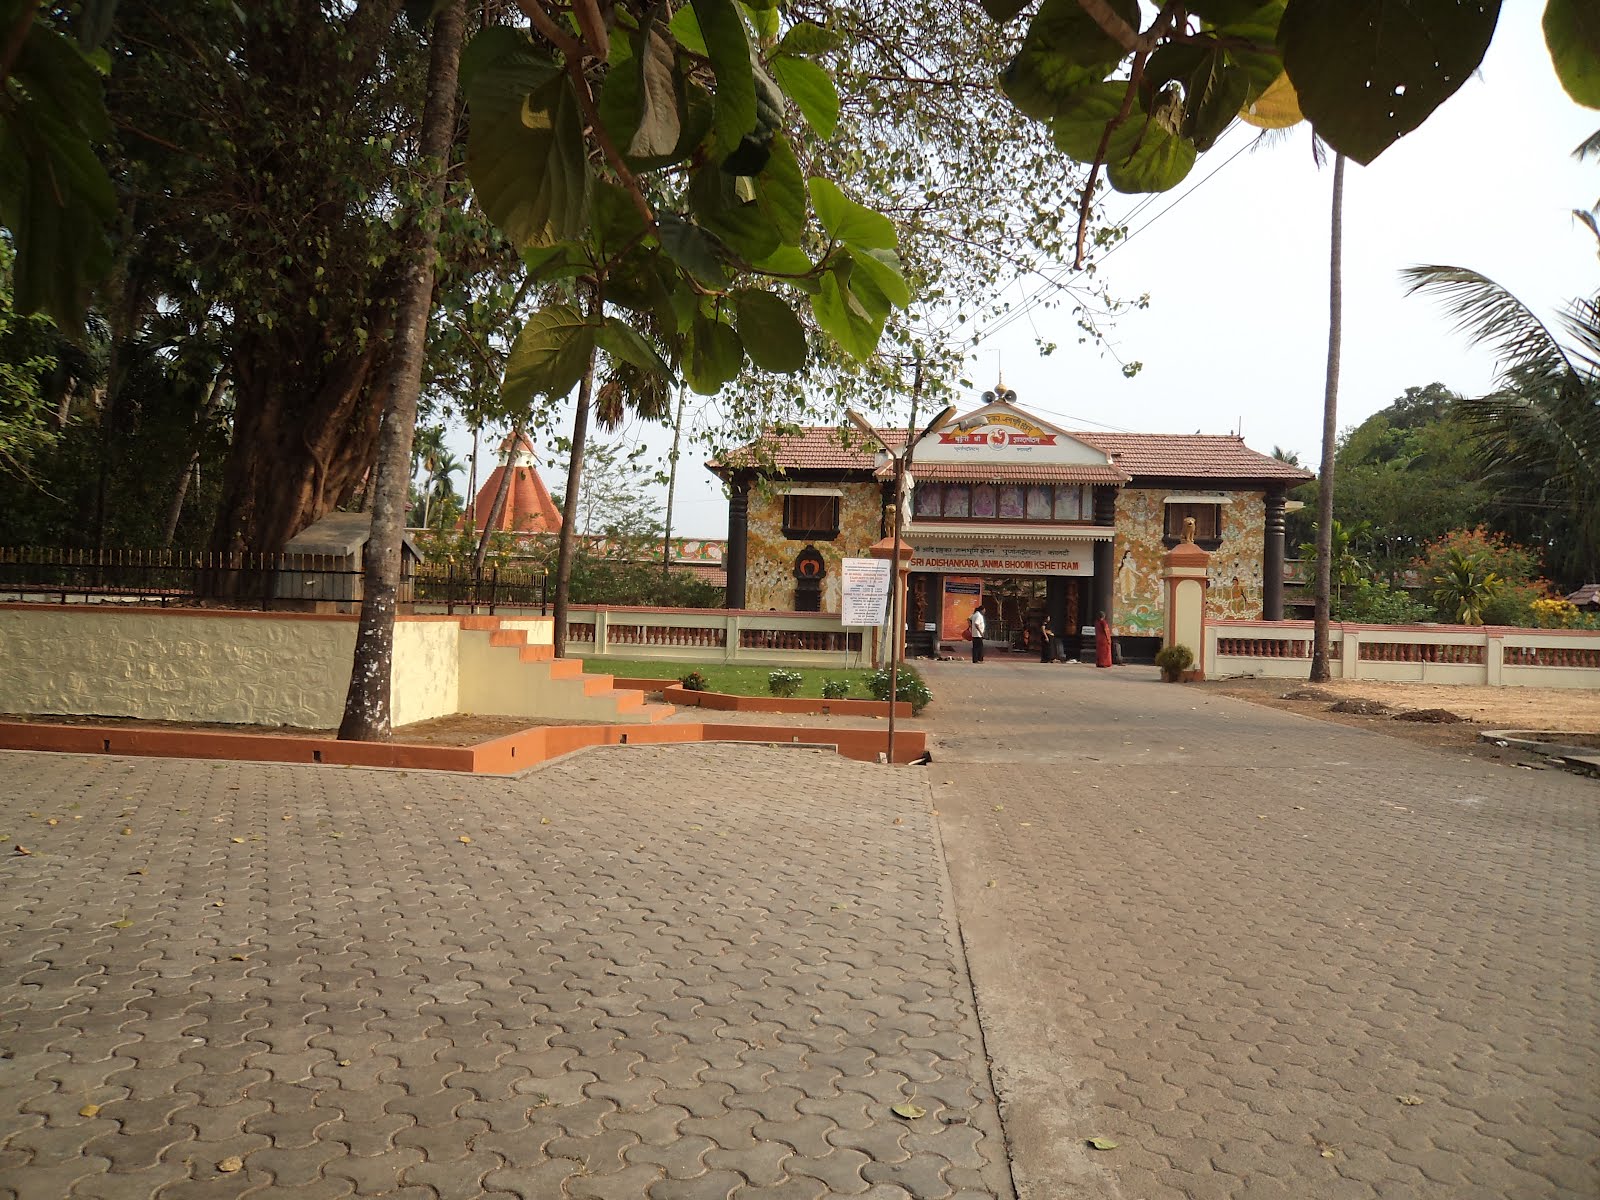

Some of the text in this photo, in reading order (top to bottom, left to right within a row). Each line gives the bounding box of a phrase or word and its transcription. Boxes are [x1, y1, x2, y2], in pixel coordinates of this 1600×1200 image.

[911, 558, 1079, 570] SRI ADISHANKARA JANMA BHOOMI KSHETRAM
